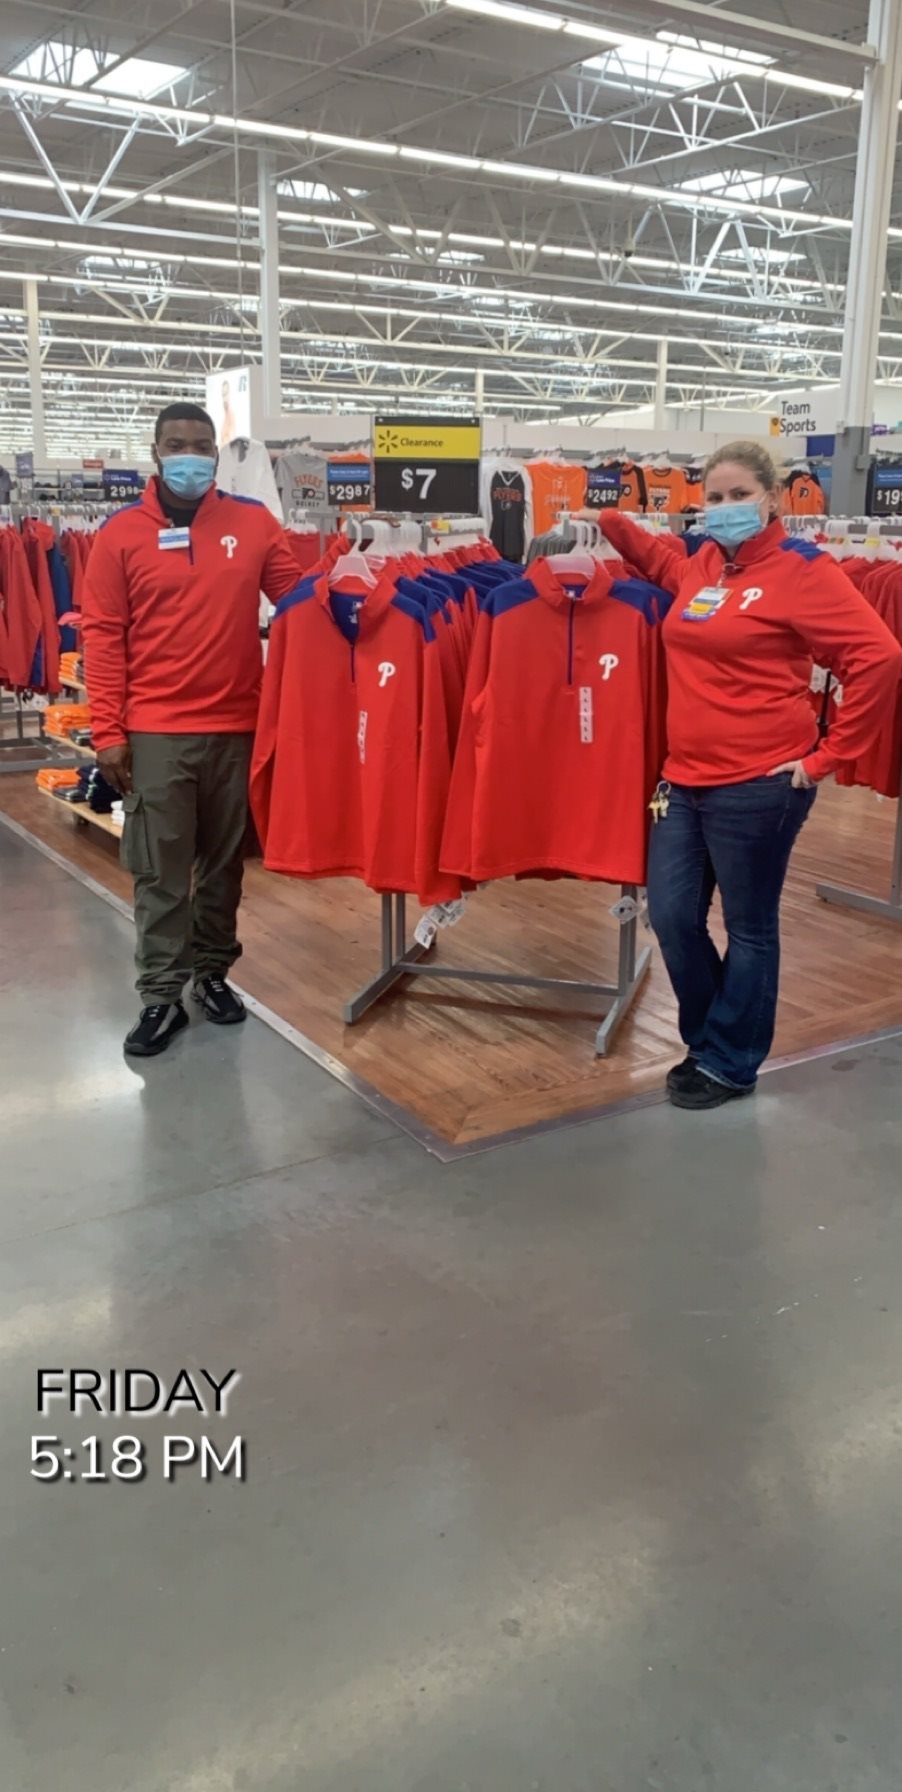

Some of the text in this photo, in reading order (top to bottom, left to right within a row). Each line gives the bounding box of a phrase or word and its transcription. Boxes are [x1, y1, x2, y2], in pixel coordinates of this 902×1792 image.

[781, 401, 810, 415] Team
[779, 418, 816, 435] Sports
[400, 438, 444, 447] Clearance
[401, 468, 437, 499] $7
